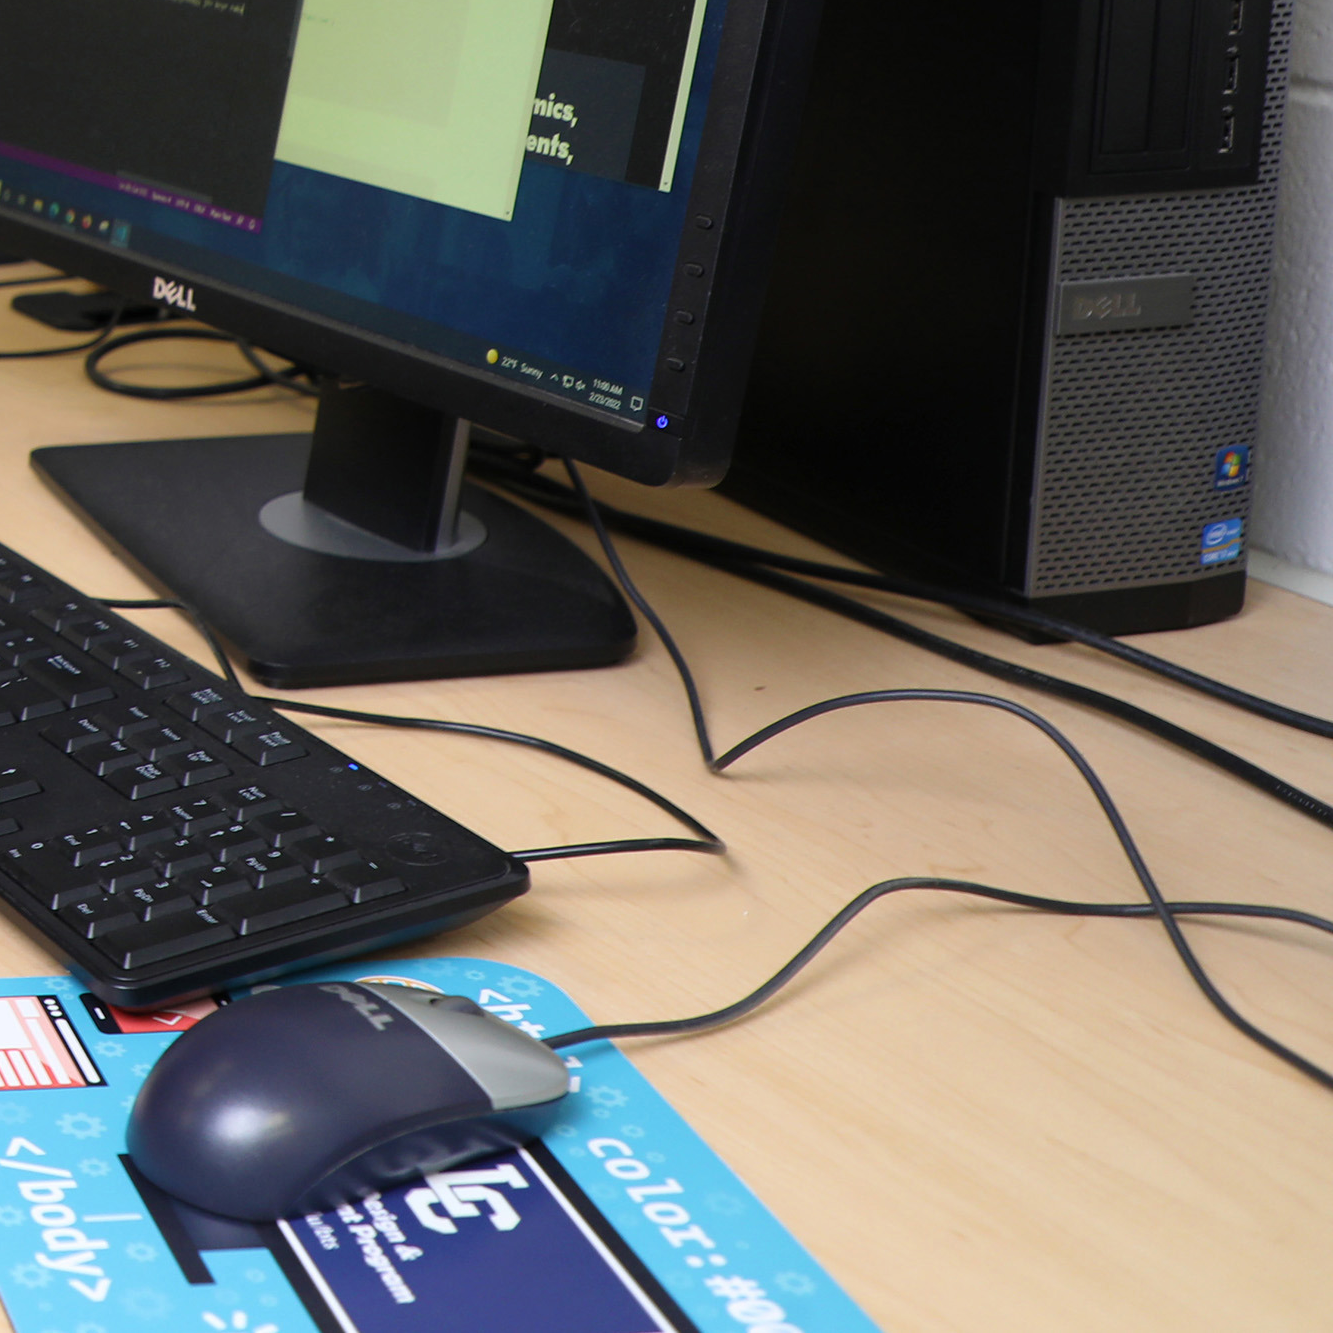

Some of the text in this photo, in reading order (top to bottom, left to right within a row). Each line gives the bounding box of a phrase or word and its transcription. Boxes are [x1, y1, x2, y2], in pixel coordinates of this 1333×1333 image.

[526, 133, 573, 165] ents,
[153, 276, 197, 312] DELL
[1073, 293, 1141, 319] DELL
[520, 362, 544, 380] Sunny
[110, 740, 128, 752] End
[192, 798, 208, 807] 7
[140, 814, 155, 822] 4
[85, 828, 99, 836] 1
[229, 824, 244, 833] 8
[30, 841, 45, 850] 0
[63, 834, 82, 847] End
[174, 838, 190, 847] 5
[8, 847, 22, 859] Ins
[119, 853, 134, 862] 2
[266, 850, 282, 858] 9
[211, 865, 227, 874] 6
[245, 856, 268, 872] PgUp
[154, 880, 170, 890] 3
[133, 887, 154, 904] PgDn
[76, 902, 95, 916] Del
[195, 908, 220, 925] Enter
[318, 984, 393, 1032] DELL
[393, 1243, 425, 1262] &
[347, 1223, 417, 1304] Program
